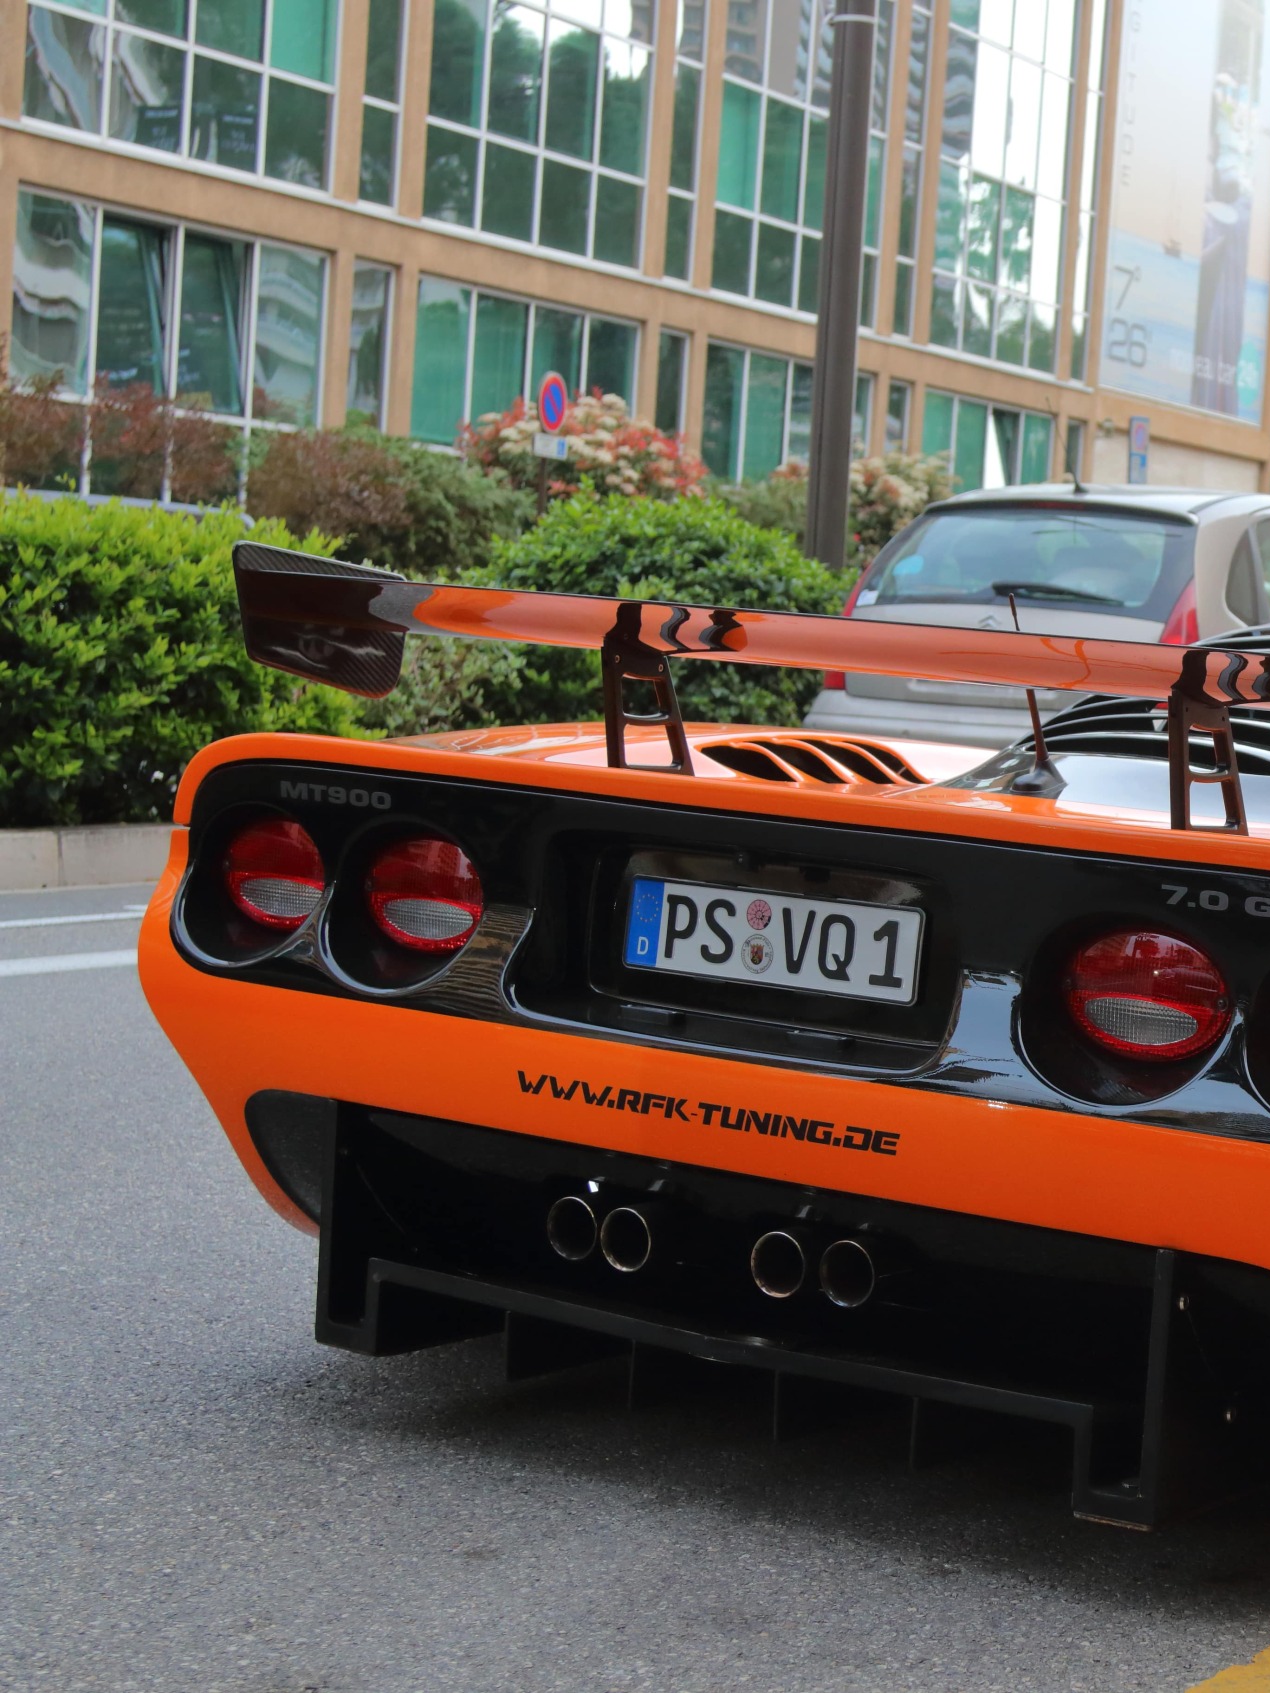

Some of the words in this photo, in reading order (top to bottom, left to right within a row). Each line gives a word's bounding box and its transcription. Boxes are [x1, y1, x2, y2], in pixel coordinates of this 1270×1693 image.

[280, 780, 391, 809] MT900
[1161, 884, 1229, 911] 7.0
[637, 936, 649, 955] D
[664, 894, 736, 964] PS
[782, 907, 856, 982] VQ
[869, 920, 902, 988] 1
[517, 1070, 900, 1156] WWW.RFK-TUNING.DE
